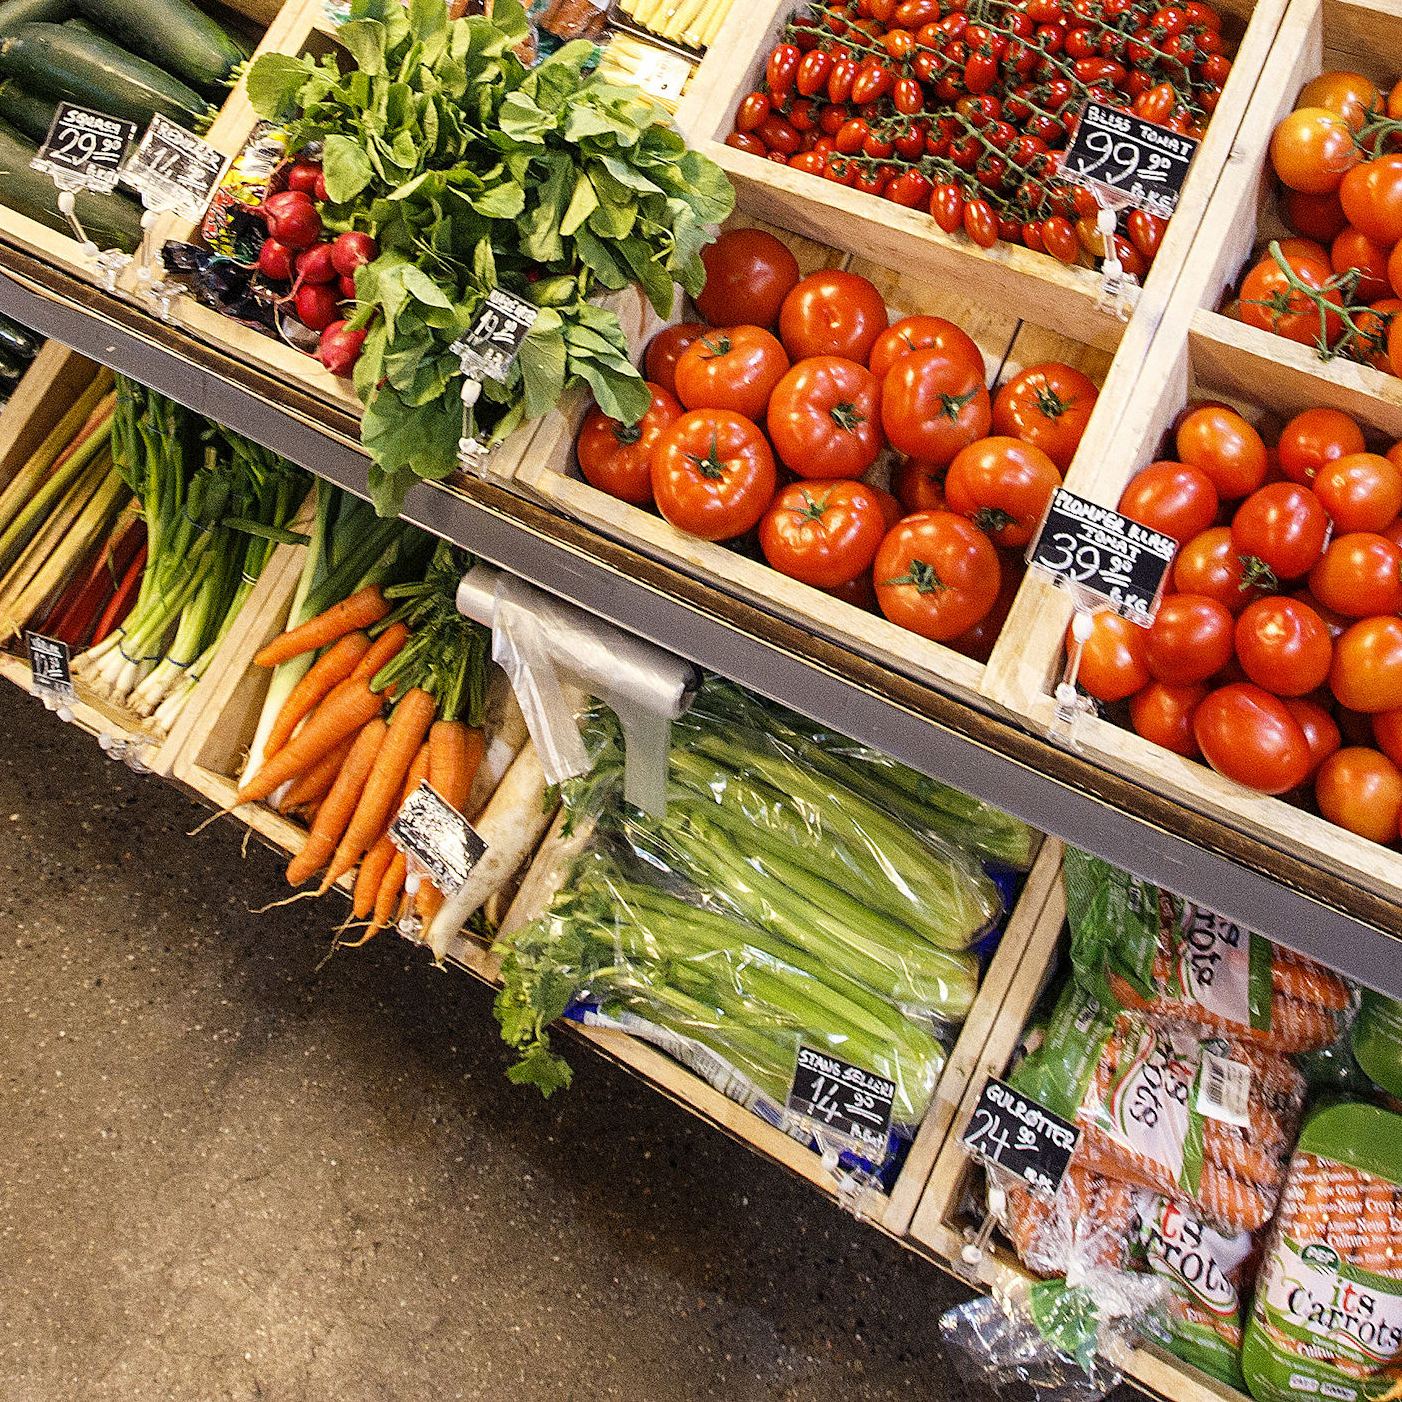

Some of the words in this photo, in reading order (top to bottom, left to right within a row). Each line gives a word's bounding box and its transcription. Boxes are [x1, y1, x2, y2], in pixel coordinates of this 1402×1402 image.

[49, 127, 97, 165] 29
[1087, 105, 1132, 132] BLISS
[1139, 124, 1193, 156] TOMAT
[1077, 131, 1140, 185] 99
[1039, 532, 1100, 581] 39
[1081, 523, 1141, 563] TOMAT
[806, 1075, 843, 1123] 14
[964, 1108, 1011, 1162] 24
[1337, 1198, 1364, 1214] New
[1364, 1199, 1396, 1215] Crop
[1288, 1287, 1402, 1349] Carrots
[1332, 1277, 1376, 1316] its
